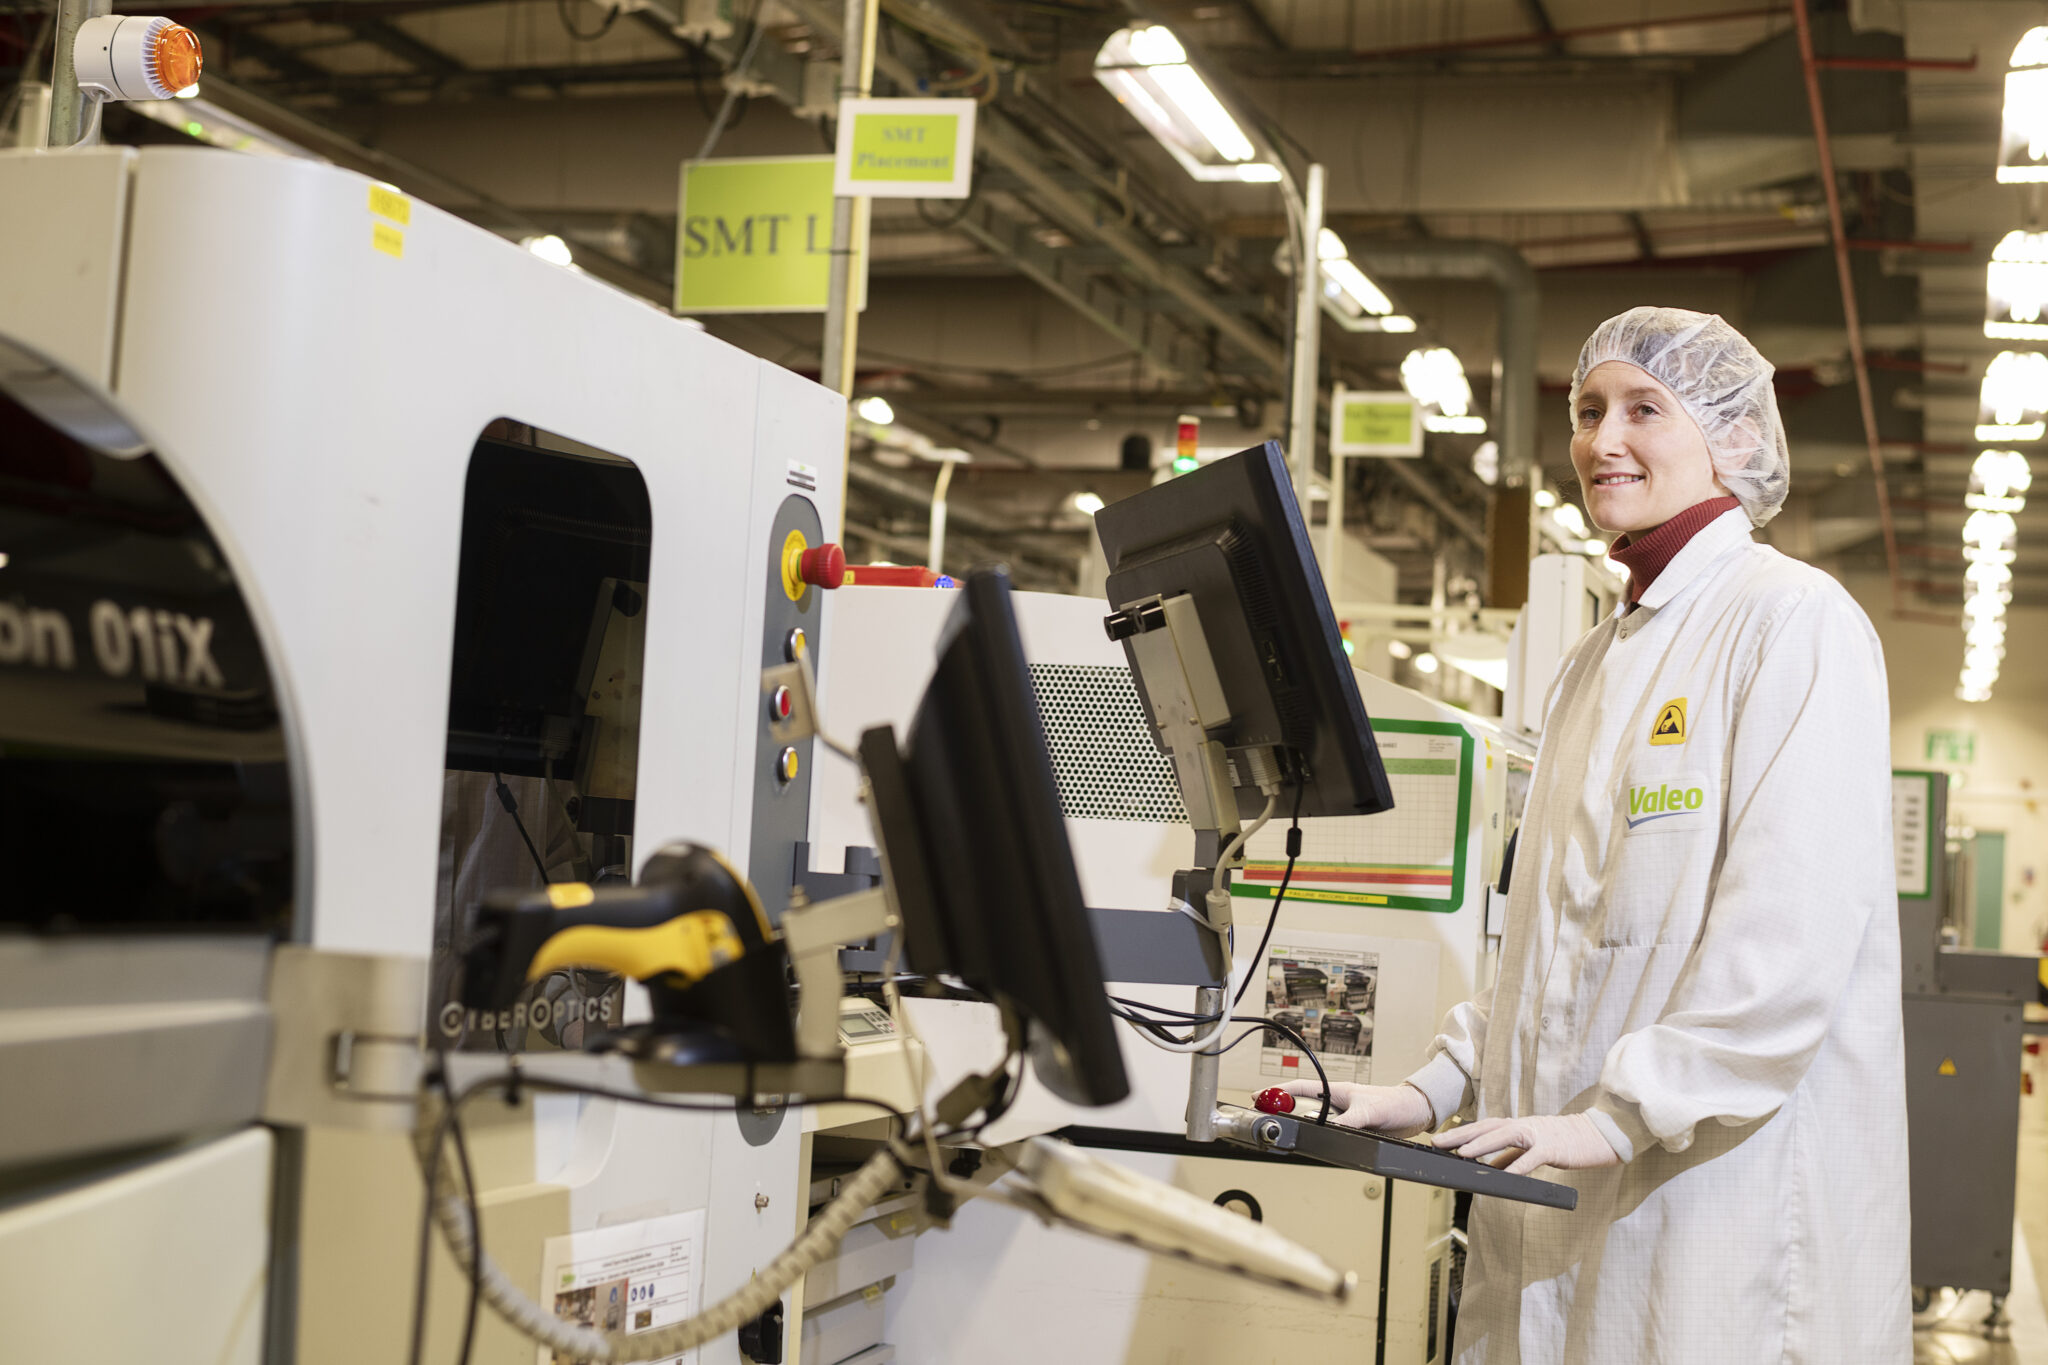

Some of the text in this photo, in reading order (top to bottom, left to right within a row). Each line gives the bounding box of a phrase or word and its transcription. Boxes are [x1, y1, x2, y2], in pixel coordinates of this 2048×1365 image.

[881, 126, 927, 144] SMT
[856, 152, 950, 169] Placement
[683, 213, 790, 258] SMT
[1629, 783, 1703, 815] Valeo
